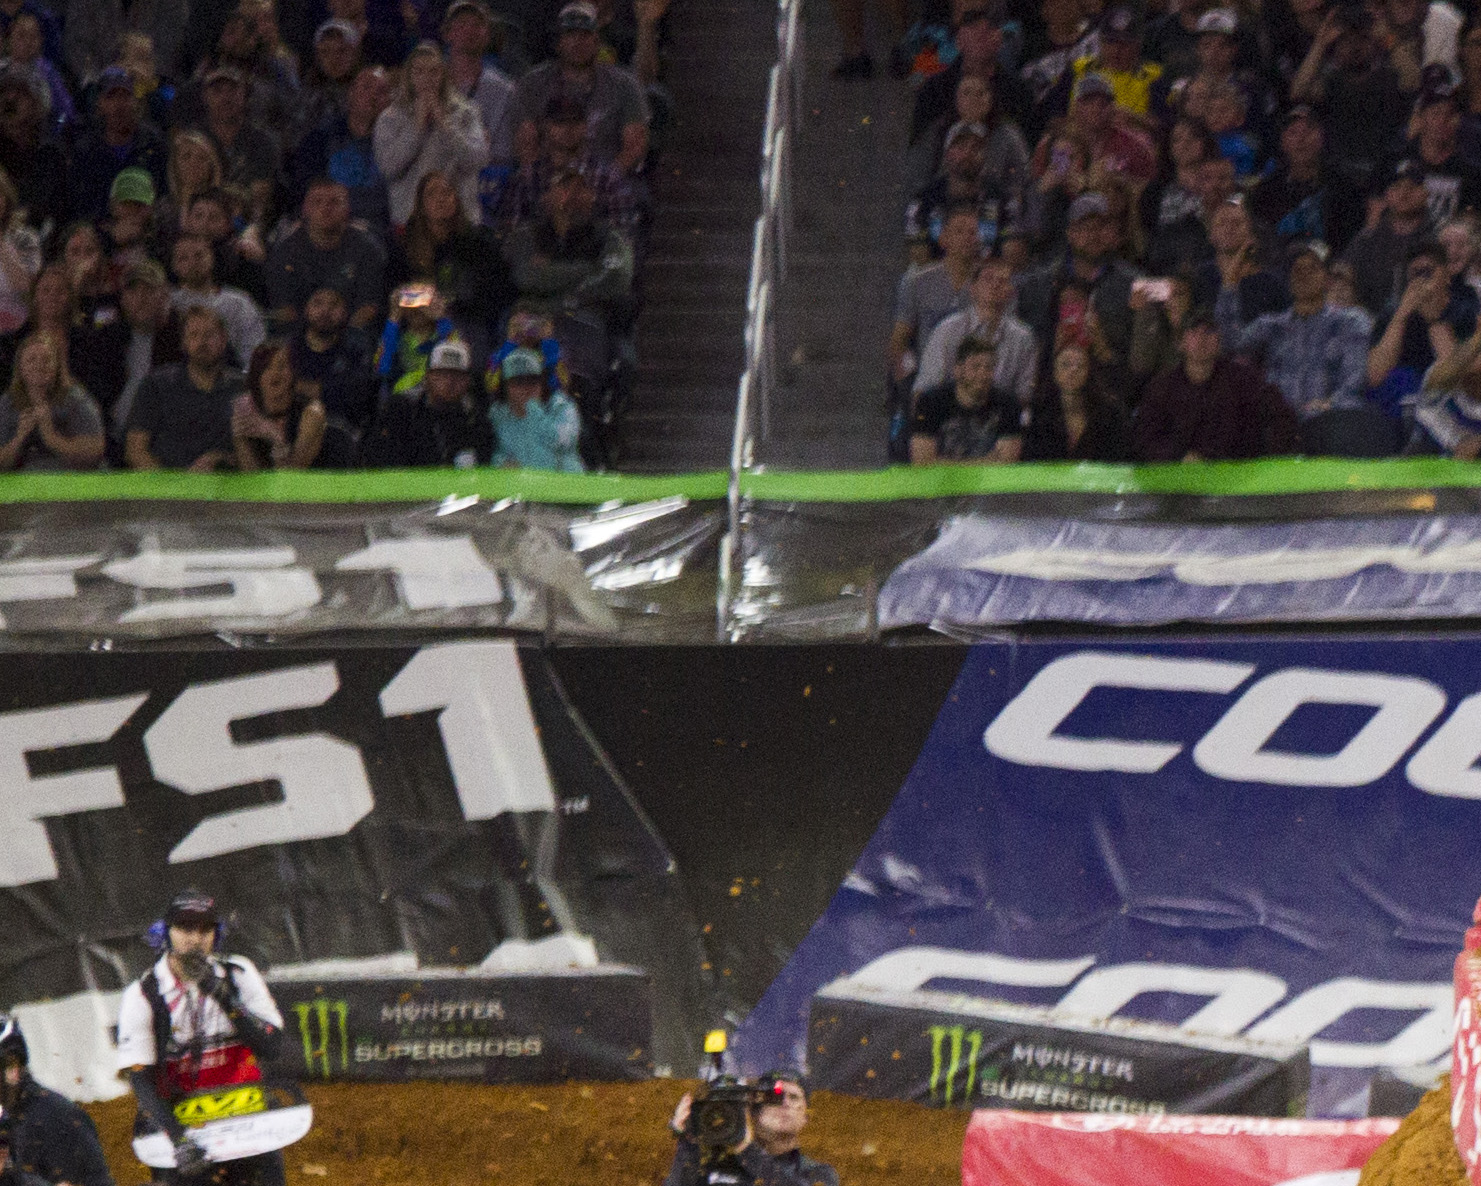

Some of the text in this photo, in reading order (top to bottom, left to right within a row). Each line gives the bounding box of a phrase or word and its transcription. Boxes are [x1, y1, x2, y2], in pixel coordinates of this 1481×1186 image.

[0, 639, 557, 887] FS1
[380, 1001, 504, 1024] MONSTER
[355, 1036, 542, 1064] SUPERCROSS
[1013, 1043, 1133, 1081] MONSTER
